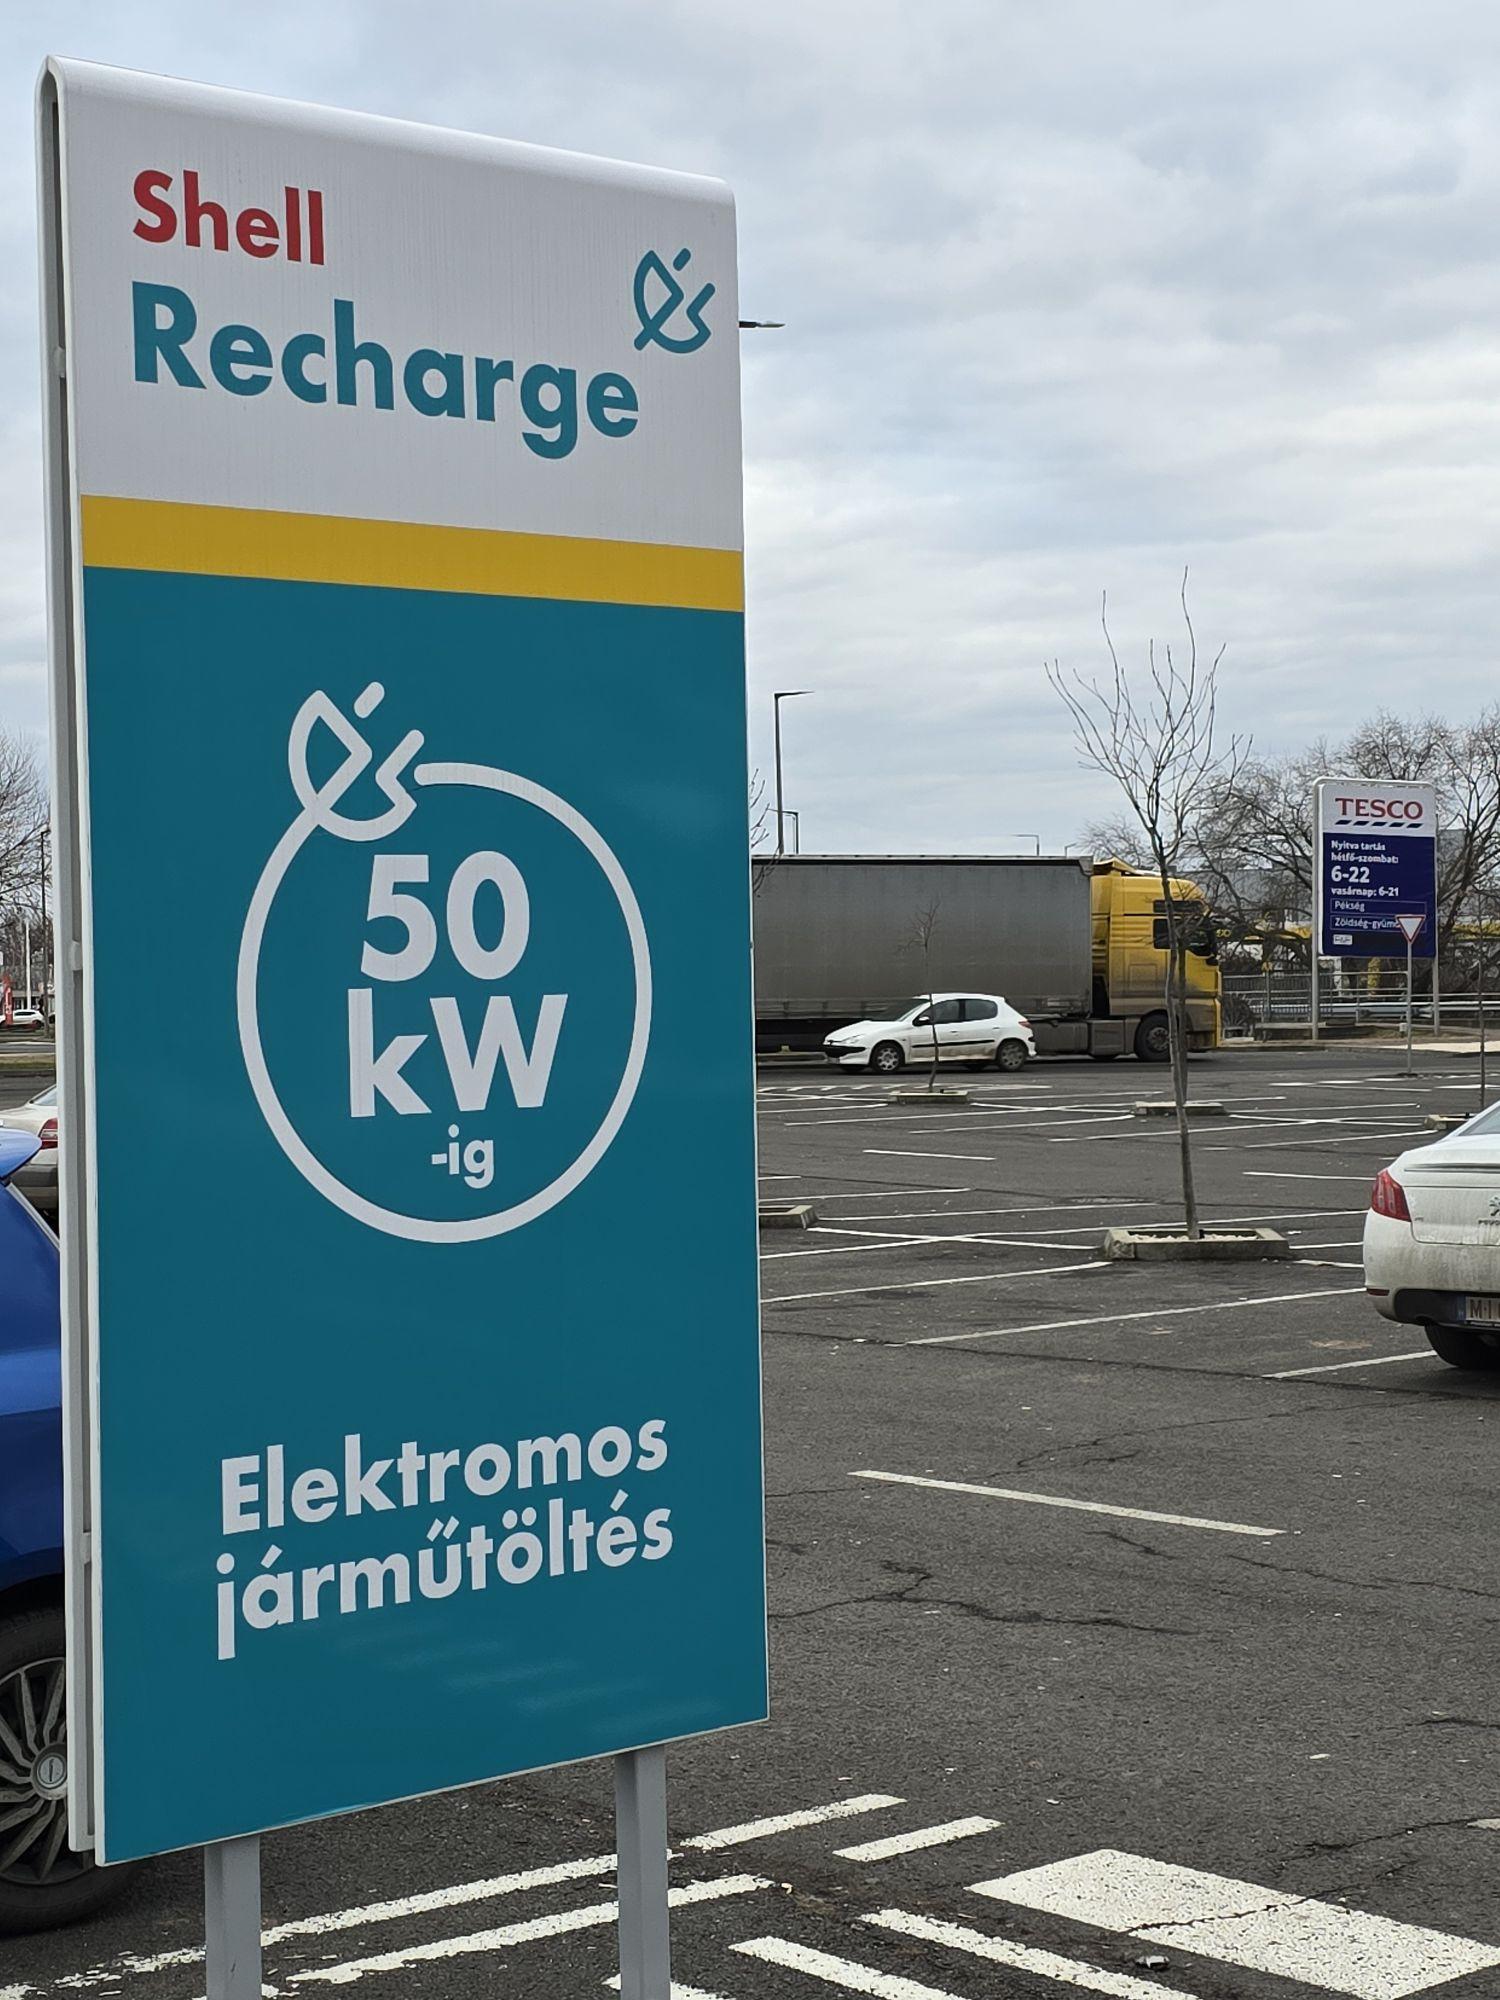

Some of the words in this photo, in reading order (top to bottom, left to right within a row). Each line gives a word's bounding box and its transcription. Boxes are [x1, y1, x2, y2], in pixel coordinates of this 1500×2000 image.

[133, 170, 324, 266] Shell
[132, 281, 638, 460] Recharge
[1331, 840, 1359, 850] Nyitva
[1360, 842, 1386, 851] tartás
[1335, 797, 1424, 820] TESCO
[1331, 865, 1370, 883] 6-22
[1331, 886, 1377, 897] vasárnap:
[1378, 886, 1399, 896] 6-21
[1334, 900, 1365, 912] Pékség
[360, 850, 531, 983] 50
[347, 987, 569, 1119] kW
[431, 1123, 495, 1190] -ig
[221, 1419, 668, 1536] Elektromos
[216, 1490, 674, 1661] járműtöltés
